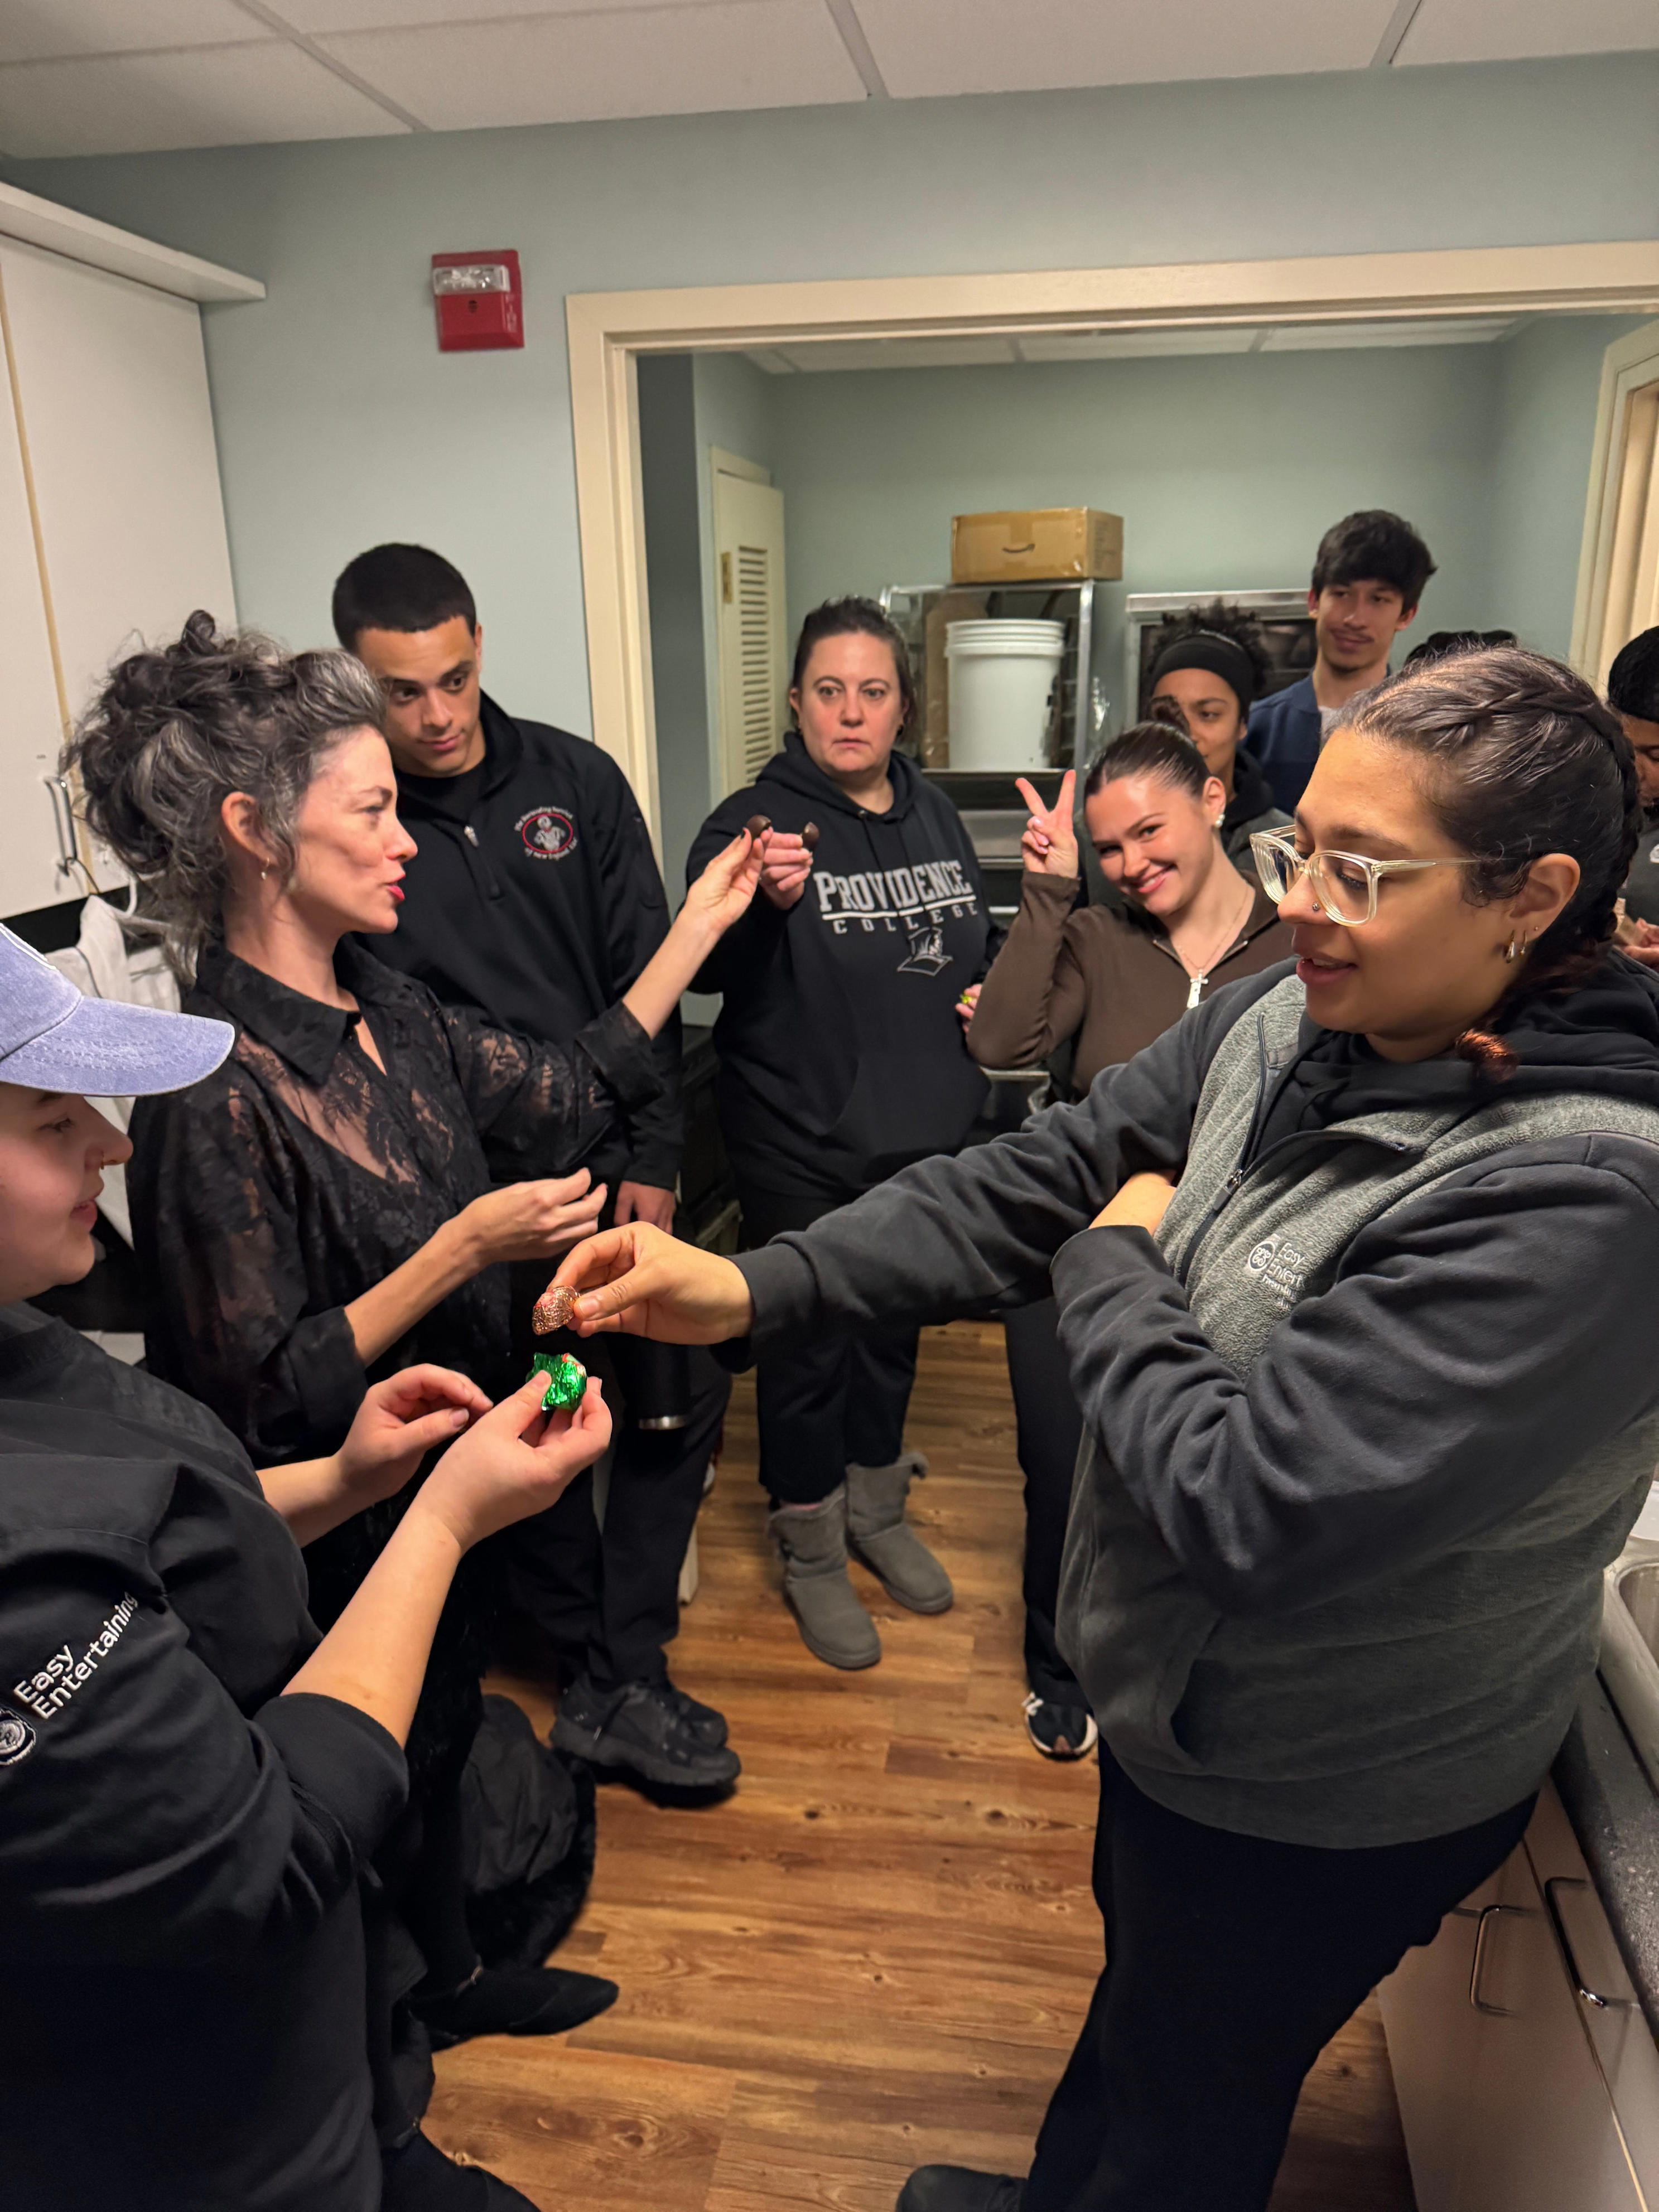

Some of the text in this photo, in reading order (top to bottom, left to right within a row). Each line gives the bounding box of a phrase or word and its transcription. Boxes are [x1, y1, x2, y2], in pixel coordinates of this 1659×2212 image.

[813, 859, 973, 912] PROVIDENCE
[833, 902, 978, 934] COLLEGE
[1278, 1242, 1305, 1267] Easy
[13, 1645, 73, 1702] Easy
[31, 1591, 138, 1720] Entertaining
